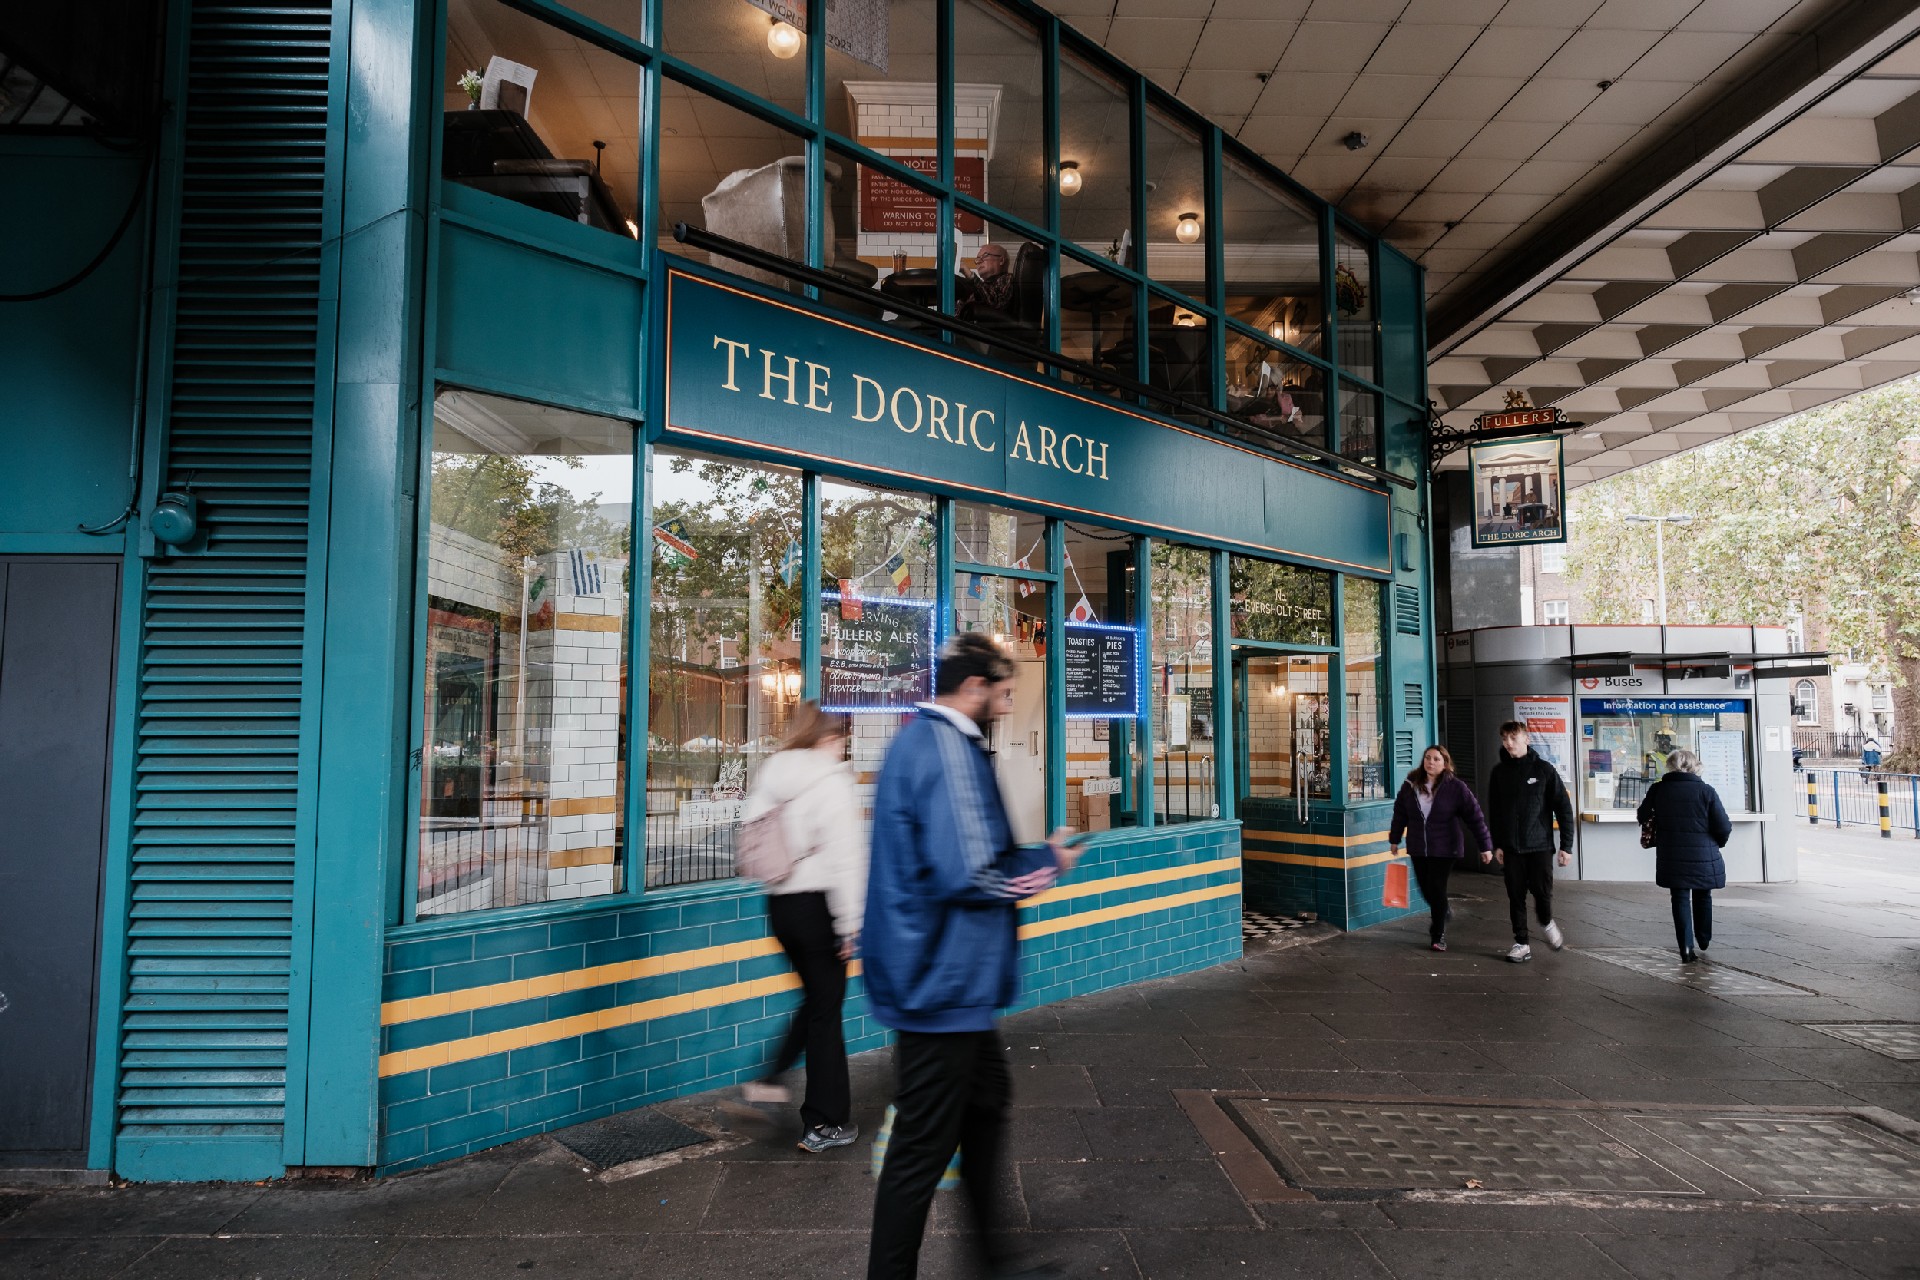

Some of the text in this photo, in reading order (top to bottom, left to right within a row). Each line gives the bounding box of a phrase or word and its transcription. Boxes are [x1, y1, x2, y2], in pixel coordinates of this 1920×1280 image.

[769, 0, 804, 28] WORLD
[903, 160, 937, 169] NOTIC
[882, 211, 936, 220] WARNING TO
[713, 334, 1109, 481] THE DORIC ARCH
[1480, 529, 1557, 541] THE DORIC ARCH
[1244, 599, 1322, 620] EVERSHOLT STREET
[829, 627, 919, 644] FULLER'S ALES
[1066, 637, 1095, 646] TOASTIES
[1106, 641, 1122, 650] PIES
[1604, 675, 1643, 687] Buses
[1603, 701, 1726, 711] Information and assistance
[688, 804, 742, 823] FULLE
